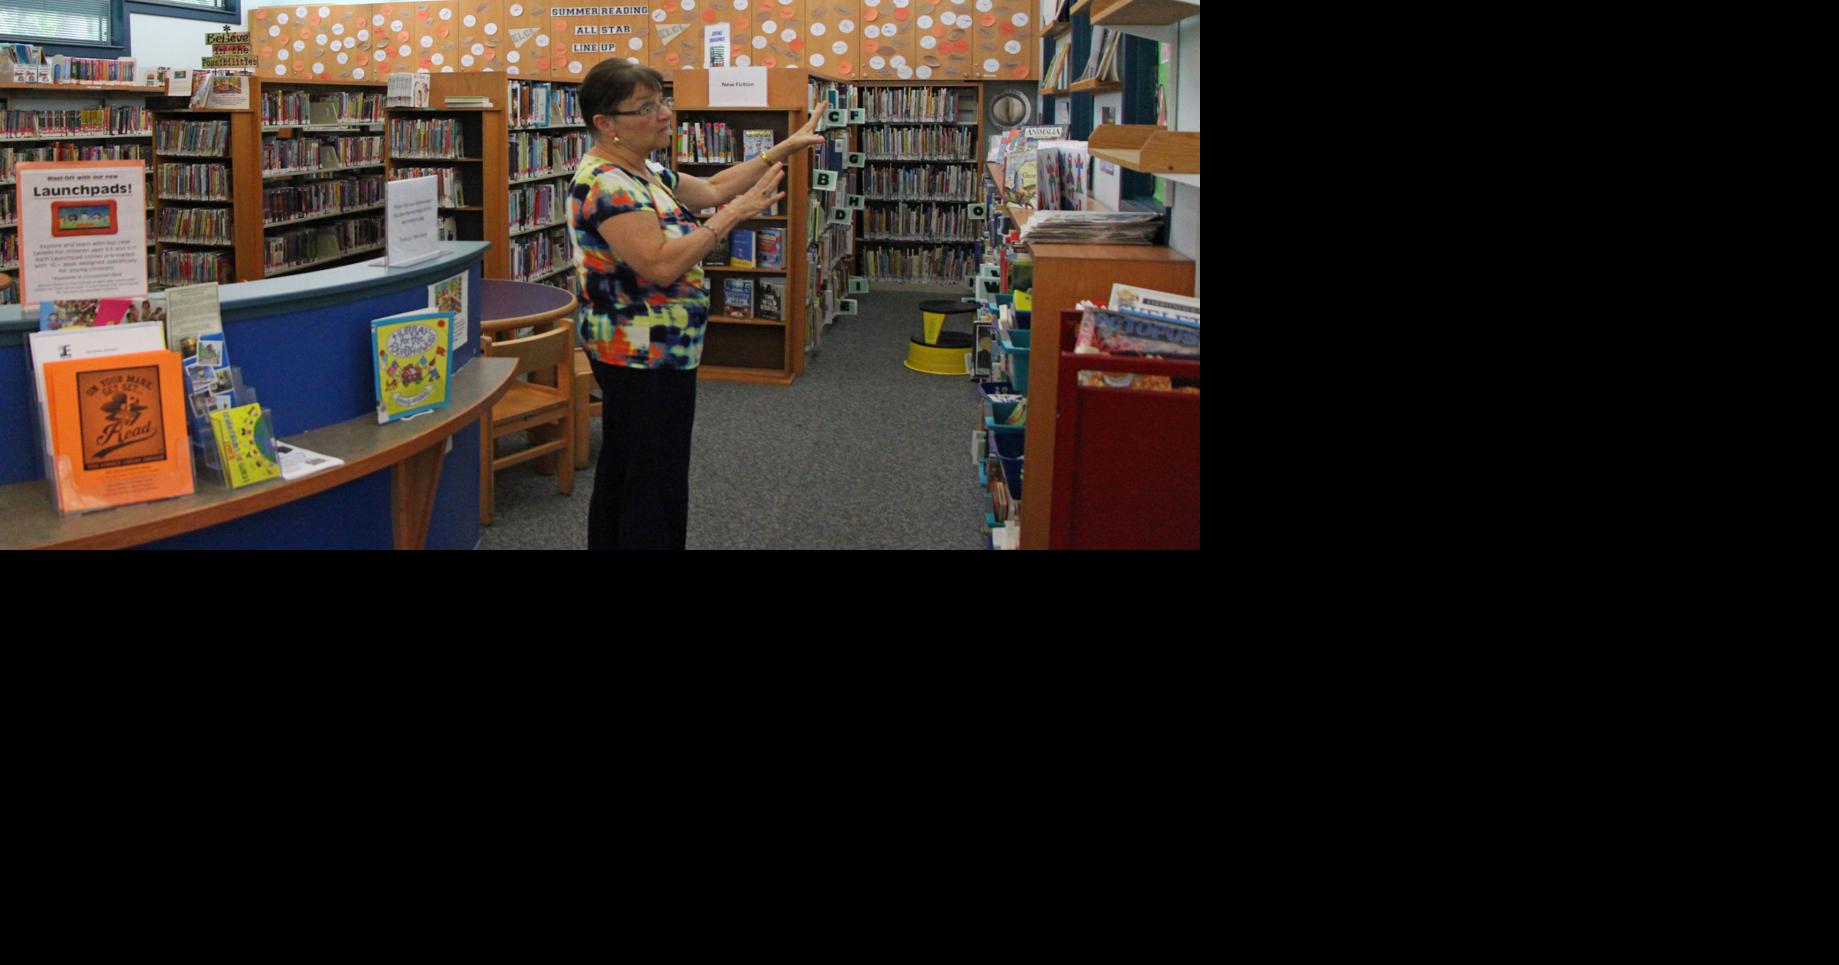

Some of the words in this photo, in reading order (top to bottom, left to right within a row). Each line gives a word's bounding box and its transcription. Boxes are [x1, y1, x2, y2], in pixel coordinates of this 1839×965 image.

[552, 7, 599, 16] SUMMER
[601, 6, 648, 15] READING
[576, 26, 597, 35] ALL
[601, 25, 631, 34] STAR
[207, 33, 249, 44] Believe
[232, 46, 249, 55] the
[573, 44, 598, 52] LINE
[601, 43, 615, 52] UP
[828, 111, 840, 122] C
[850, 111, 859, 120] F
[849, 154, 859, 164] G
[817, 173, 829, 186] B
[33, 183, 132, 197] Launchpads!
[848, 196, 859, 206] H
[835, 209, 846, 220] D
[973, 206, 984, 216] O
[96, 420, 152, 446] Read
